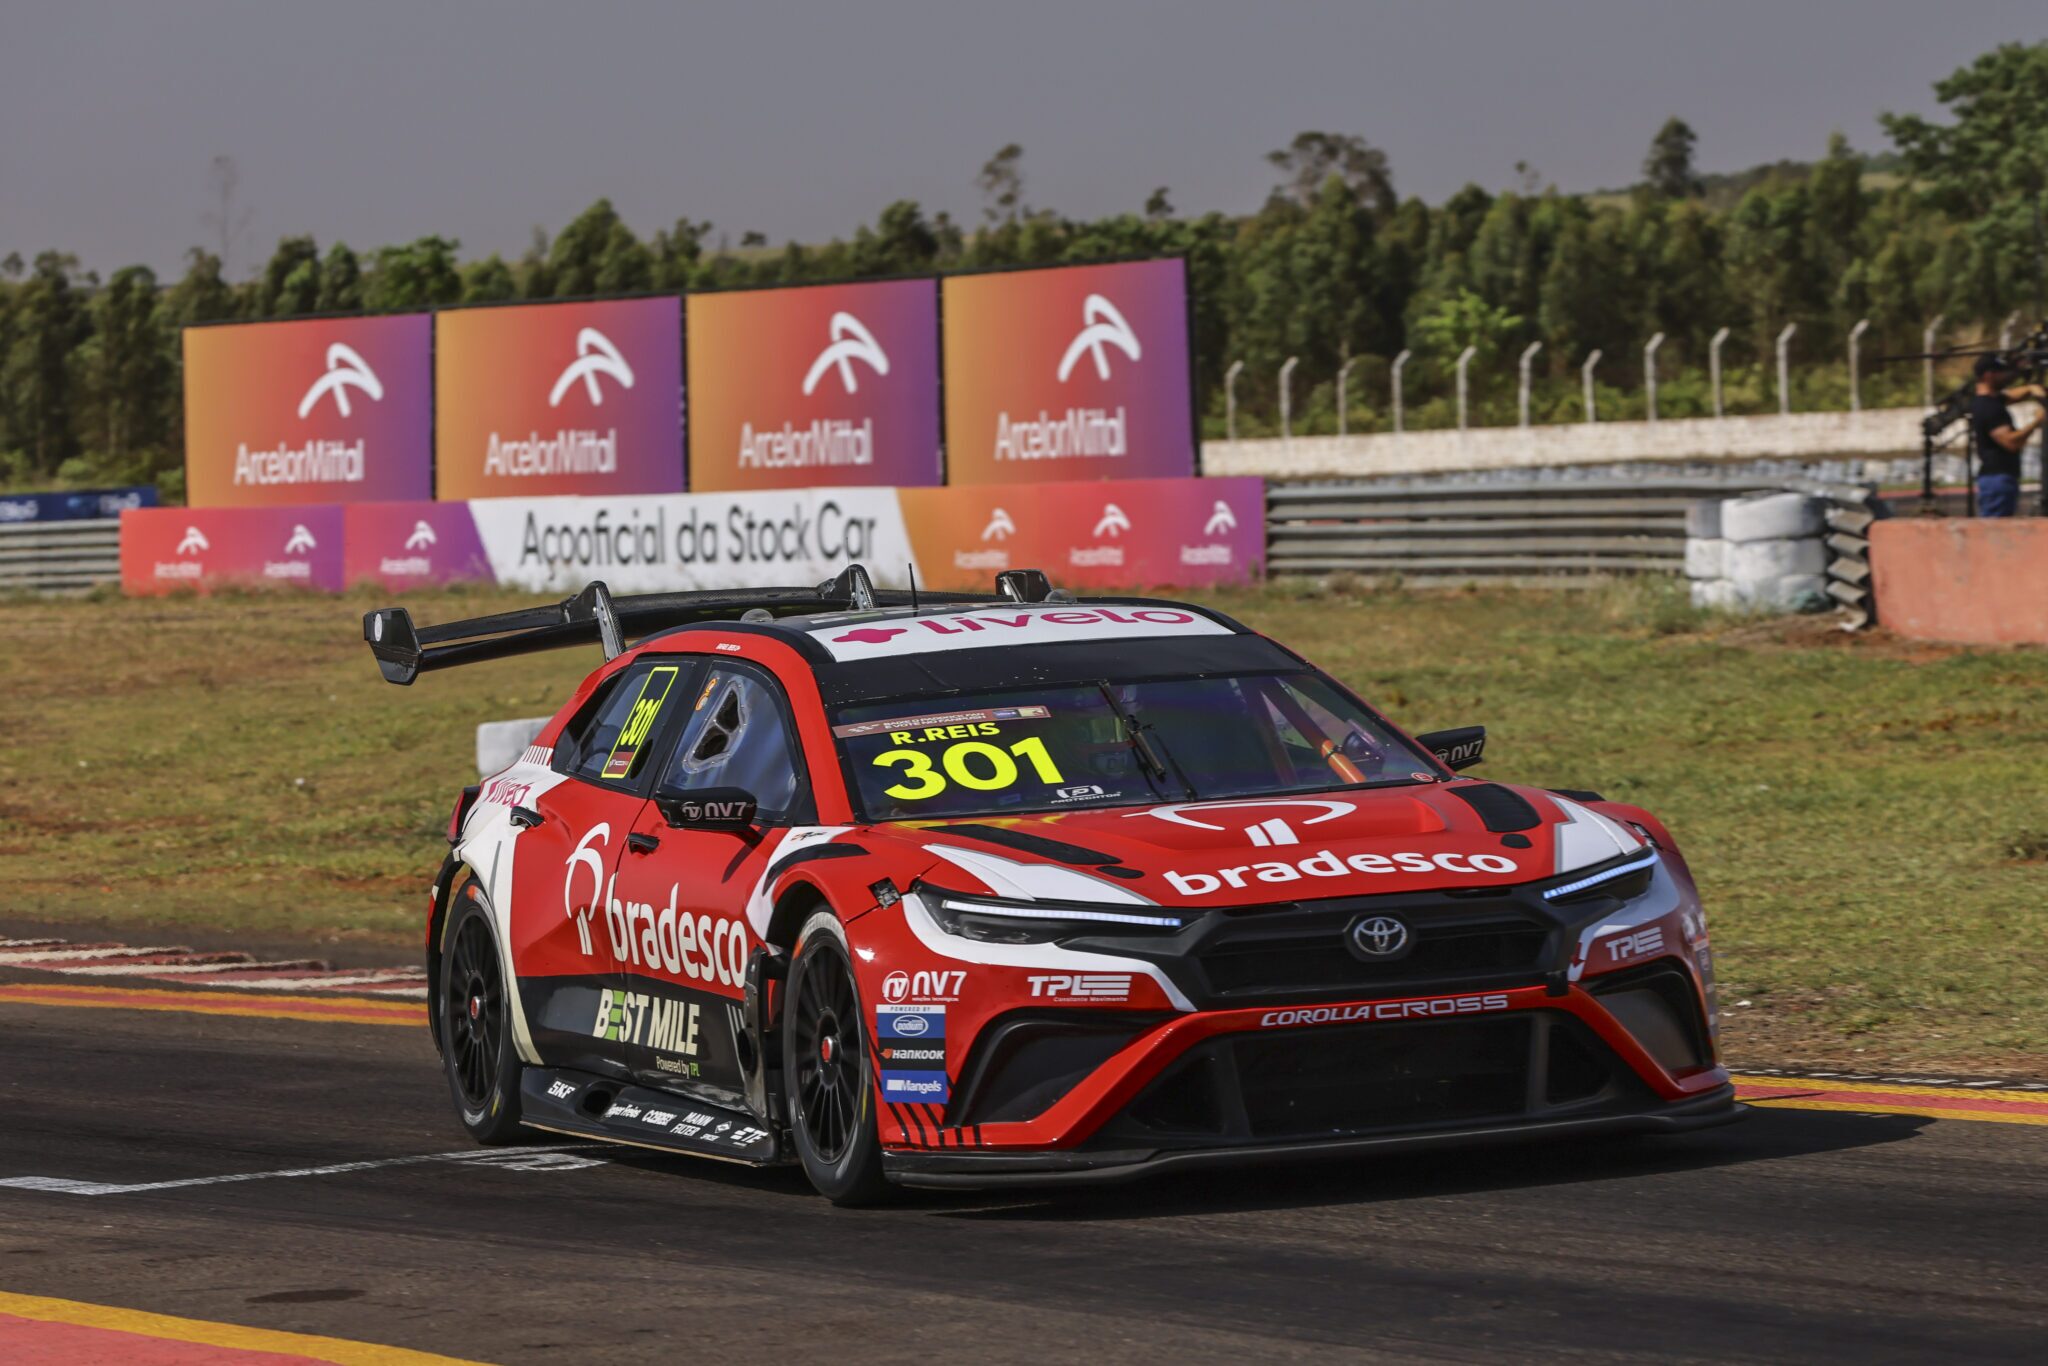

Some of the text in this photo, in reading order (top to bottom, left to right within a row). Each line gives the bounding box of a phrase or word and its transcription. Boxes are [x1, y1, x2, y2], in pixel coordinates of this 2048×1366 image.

[484, 429, 617, 476] ArcelorMittal
[739, 418, 872, 469] ArcelorMittal
[995, 407, 1126, 460] ArcelorMittal
[234, 440, 364, 485] ArcelorMittal
[676, 507, 718, 563] da
[728, 504, 810, 563] Stock
[817, 501, 876, 561] Car
[890, 722, 1000, 746] R.REIS
[872, 736, 1065, 800] 301
[1162, 850, 1518, 896] bradesco
[605, 872, 748, 988] bradesco
[646, 996, 700, 1056] MILE
[1261, 994, 1509, 1026] COROLLA CROSS
[547, 1080, 577, 1099] SKF
[680, 1060, 690, 1079] by
